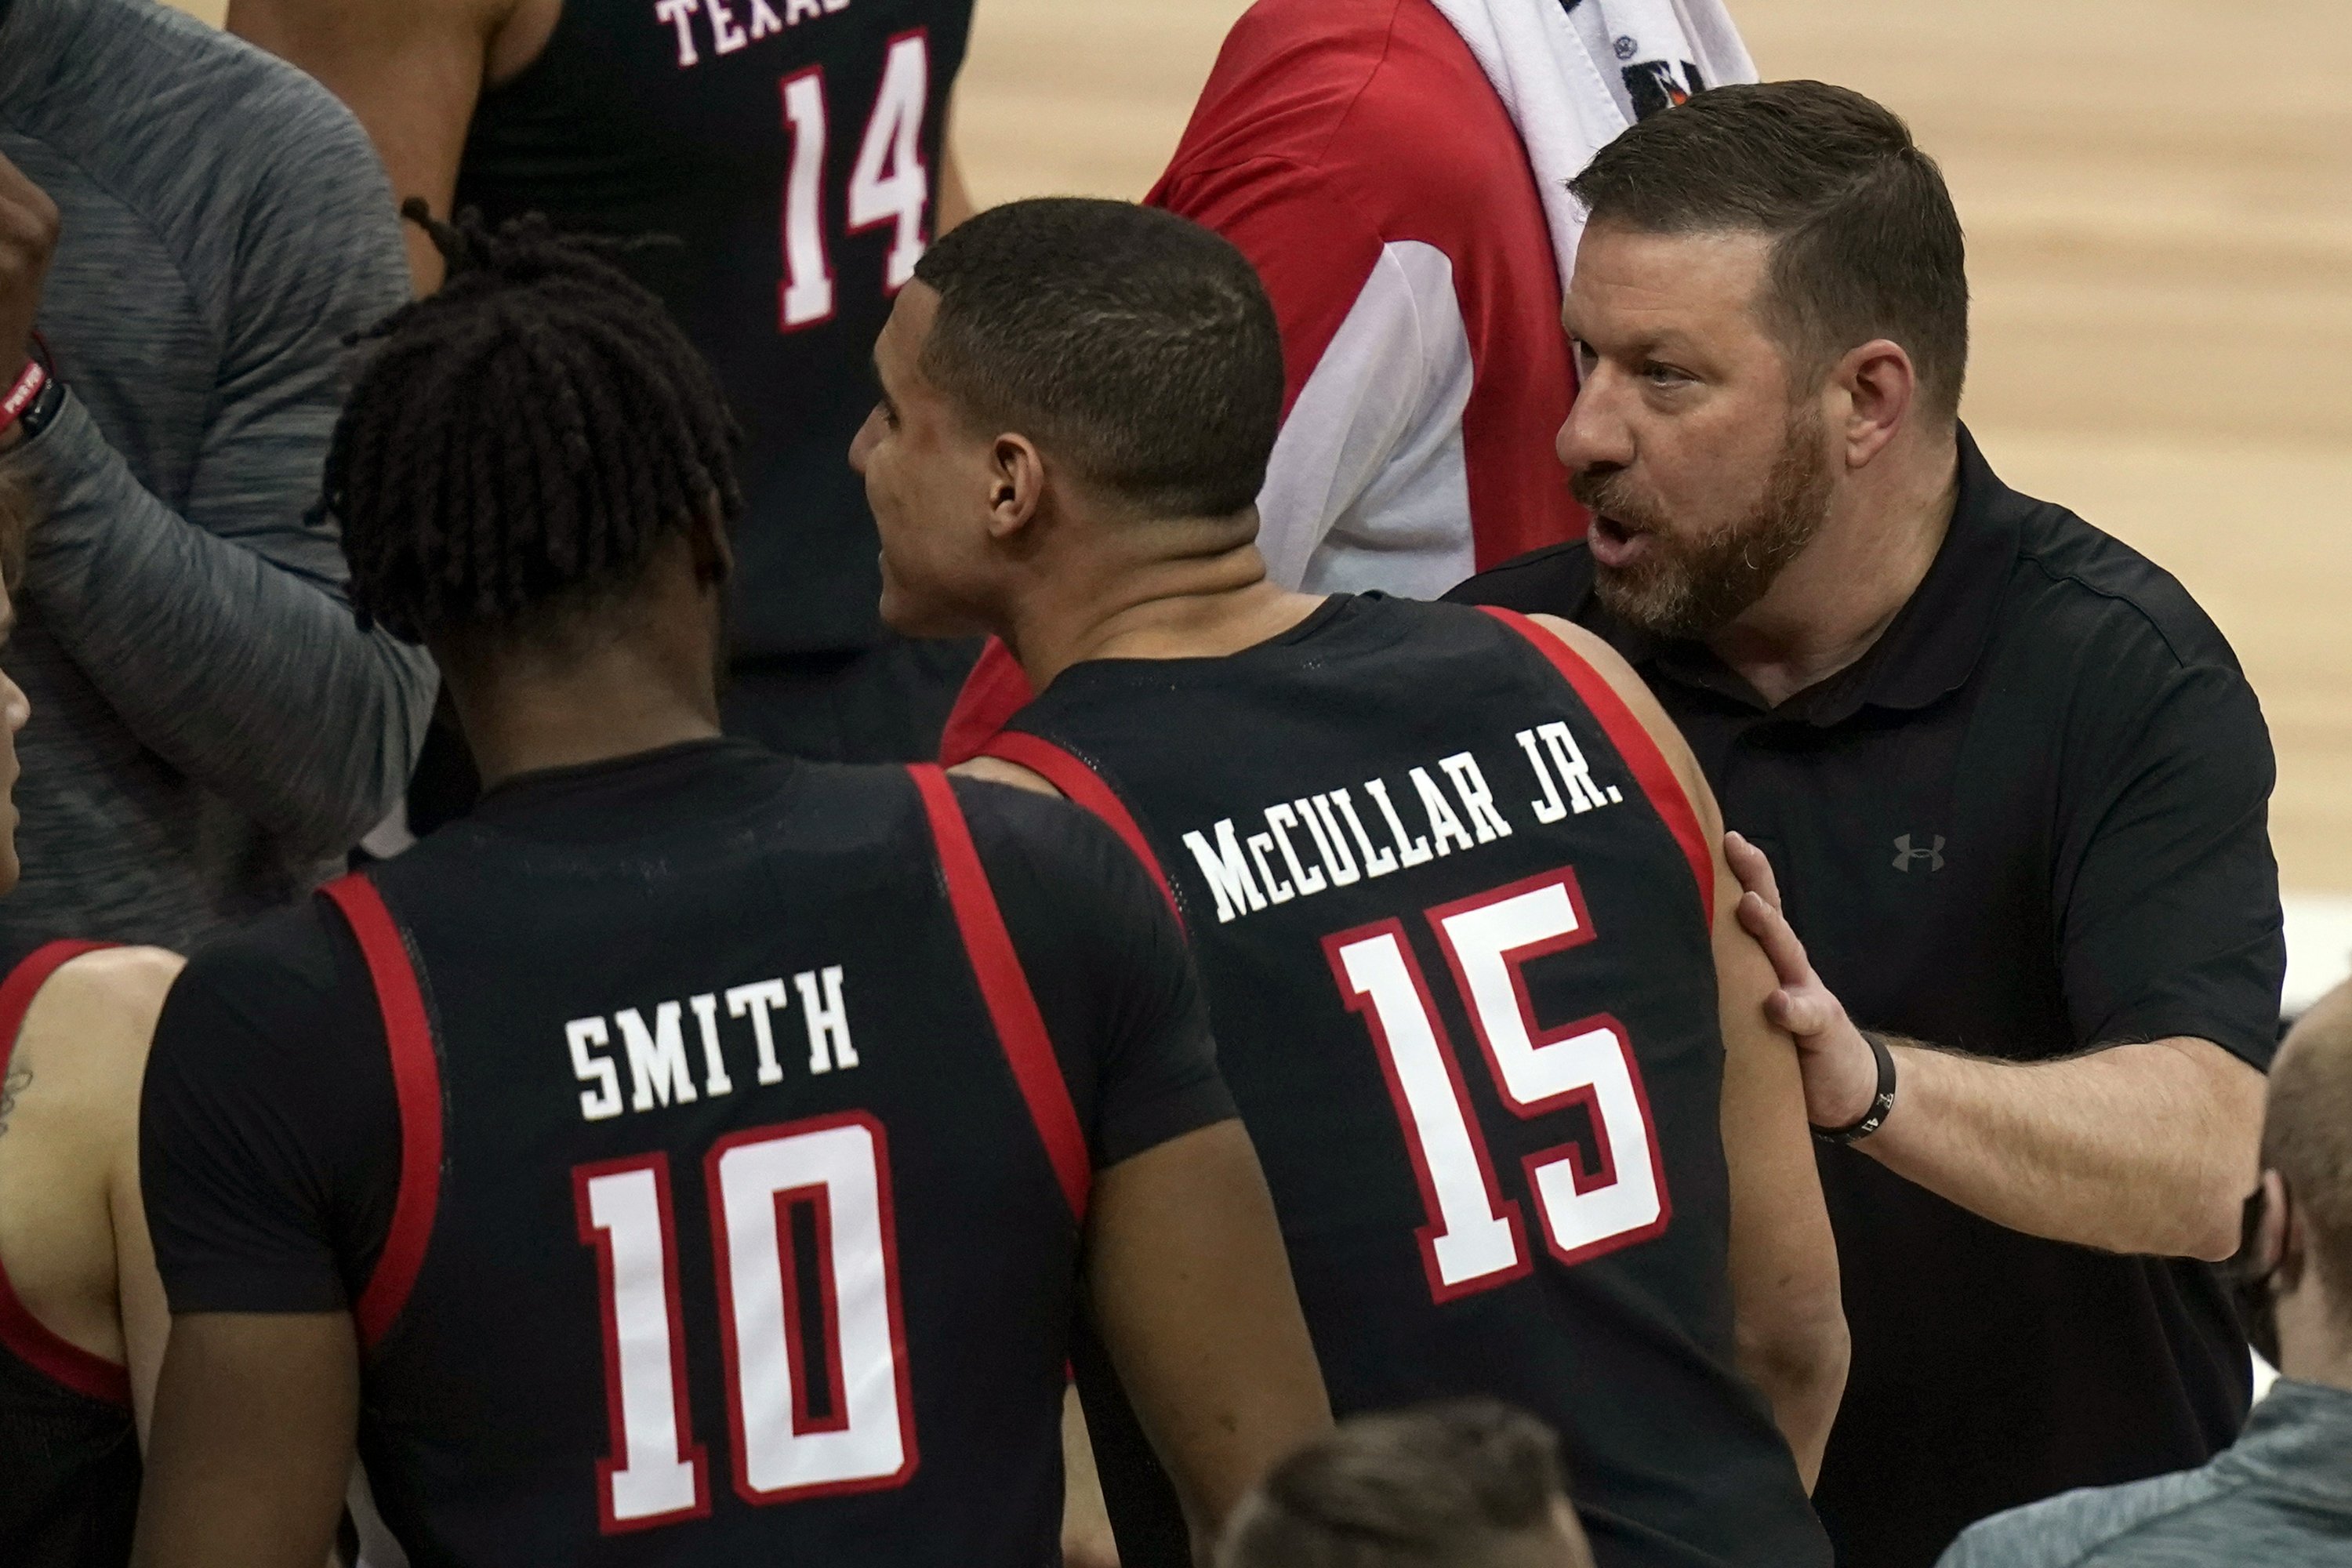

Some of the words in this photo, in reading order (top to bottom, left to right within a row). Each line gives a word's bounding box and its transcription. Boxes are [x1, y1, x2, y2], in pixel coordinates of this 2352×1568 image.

[654, 0, 851, 67] TEX
[780, 27, 928, 333] 14
[1183, 751, 1512, 924] McCULLAR
[1515, 720, 1623, 826] JR.
[565, 965, 859, 1121] SMITH
[1320, 865, 1673, 1305] 15
[572, 1108, 920, 1535] 10
